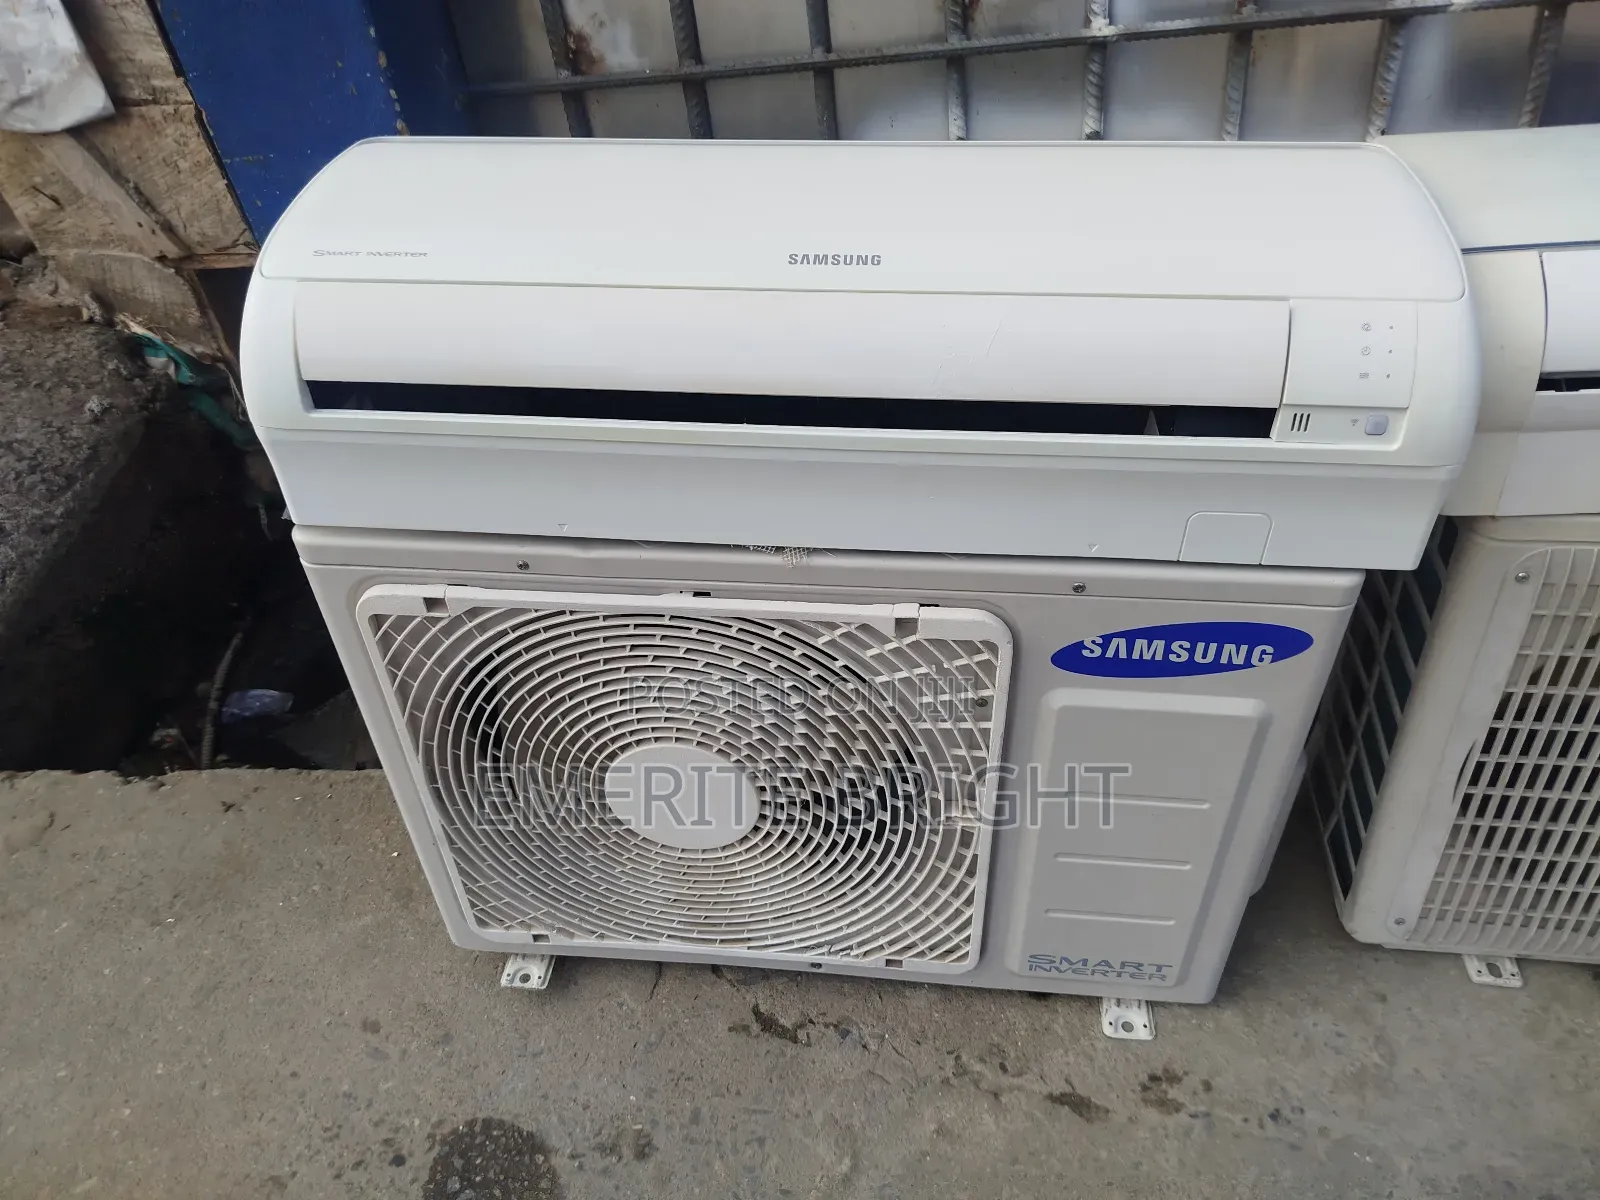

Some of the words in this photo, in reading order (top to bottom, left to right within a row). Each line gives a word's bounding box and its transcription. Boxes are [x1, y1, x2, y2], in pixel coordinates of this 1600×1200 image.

[787, 253, 882, 266] SAMSUNG
[1081, 636, 1275, 667] SAMSUNG
[1027, 953, 1173, 973] SMART
[1028, 963, 1168, 982] INVERTER
